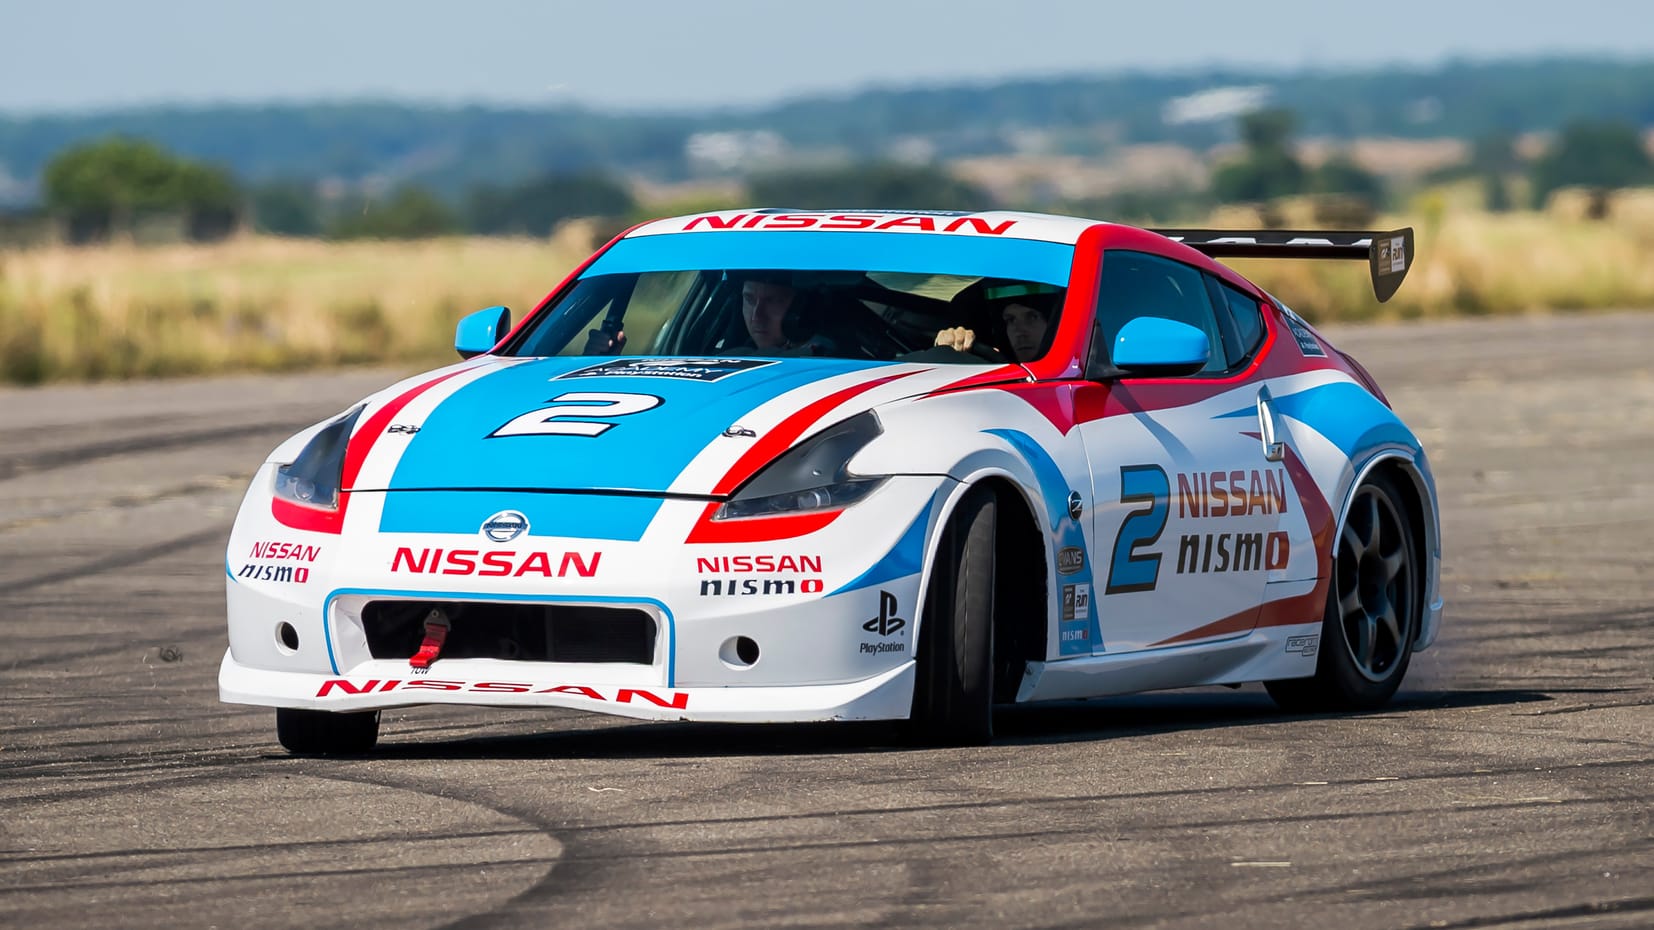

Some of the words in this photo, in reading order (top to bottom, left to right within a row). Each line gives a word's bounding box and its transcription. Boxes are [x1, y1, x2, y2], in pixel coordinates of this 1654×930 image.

[683, 214, 1019, 235] NISSAN
[482, 392, 666, 440] 2
[1177, 469, 1287, 518] NISSAN
[1105, 464, 1171, 595] 2
[249, 541, 321, 562] NISSAN
[391, 547, 602, 577] NISSAN
[697, 555, 822, 573] NISSAN
[1176, 530, 1290, 574] nismo
[238, 563, 308, 583] nismo
[700, 579, 824, 596] nismo
[860, 641, 904, 656] PlayStation
[316, 679, 689, 709] NISSAN
